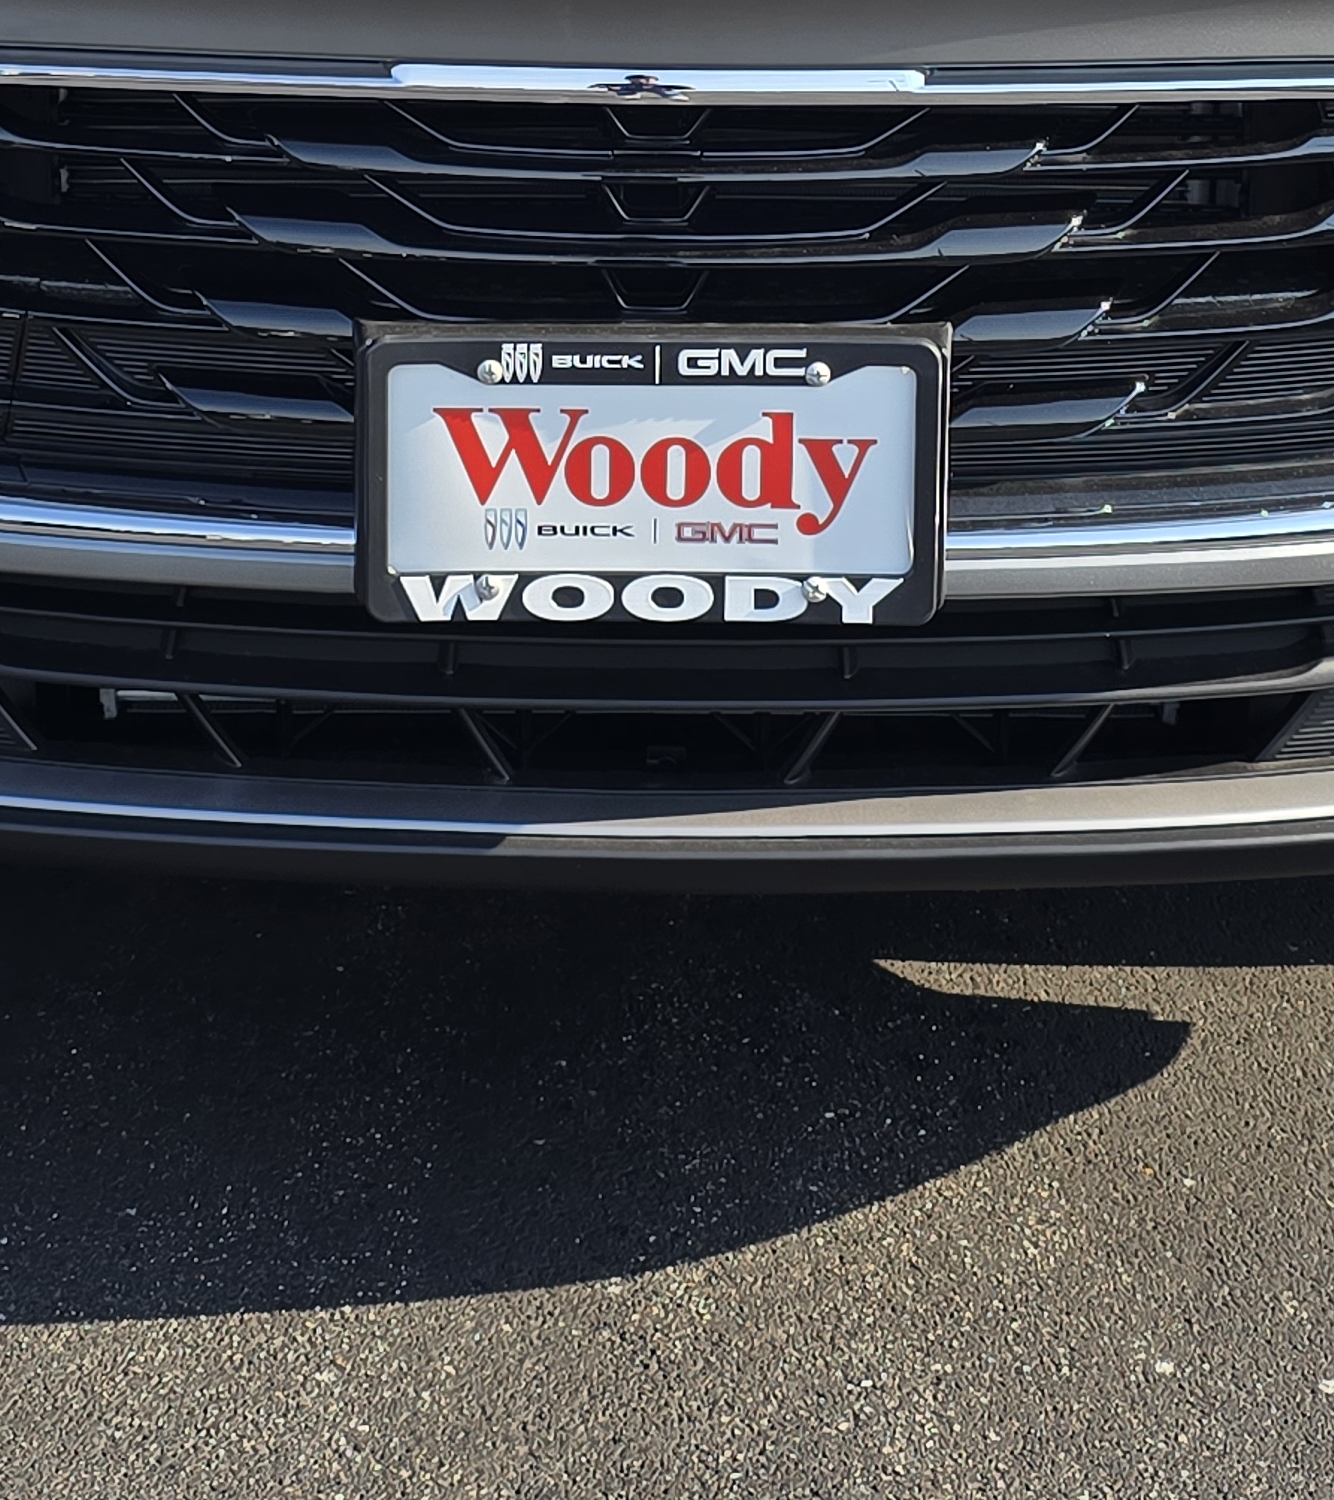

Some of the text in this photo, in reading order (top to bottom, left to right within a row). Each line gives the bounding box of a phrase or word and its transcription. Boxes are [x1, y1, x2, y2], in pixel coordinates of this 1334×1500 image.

[551, 347, 807, 377] BUICK GMC
[433, 407, 878, 536] Woody
[536, 521, 780, 546] BUICK GMC
[399, 573, 905, 624] WOODY
